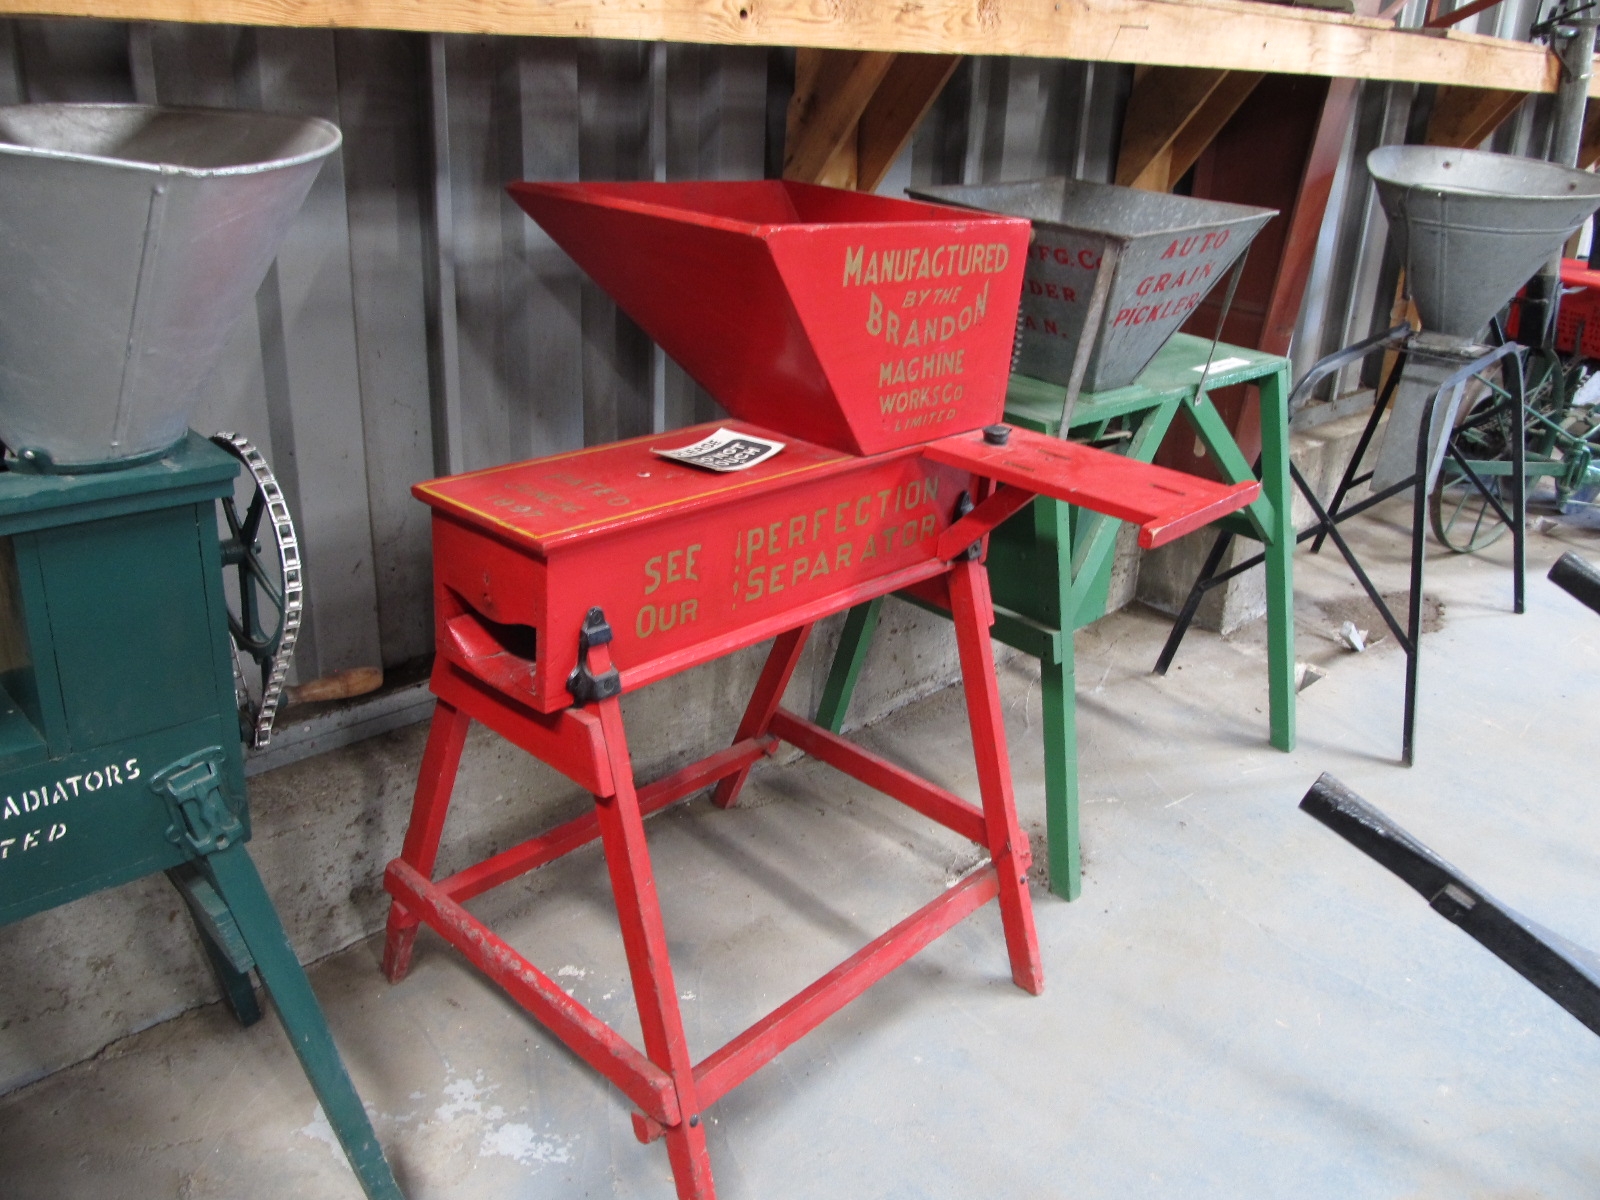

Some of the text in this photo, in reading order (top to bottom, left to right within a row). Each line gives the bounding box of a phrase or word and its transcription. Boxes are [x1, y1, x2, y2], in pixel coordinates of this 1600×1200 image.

[1161, 229, 1230, 260] AUTO
[843, 243, 1009, 287] MANUFACTURED
[1136, 261, 1216, 297] GRAIN
[902, 286, 963, 308] BY THE
[1021, 280, 1076, 302] DER
[1113, 292, 1200, 327] PICKLER
[866, 279, 989, 347] BRANDON
[879, 349, 965, 388] MACHINE
[879, 385, 940, 415] WORKS
[895, 409, 956, 432] LIMITED
[745, 476, 939, 565] PERFECTION
[644, 543, 702, 595] SEE
[745, 514, 937, 602] SEPARATOR
[635, 599, 699, 639] OUR
[3, 758, 141, 820] ADIATORS
[0, 823, 67, 859] TED
